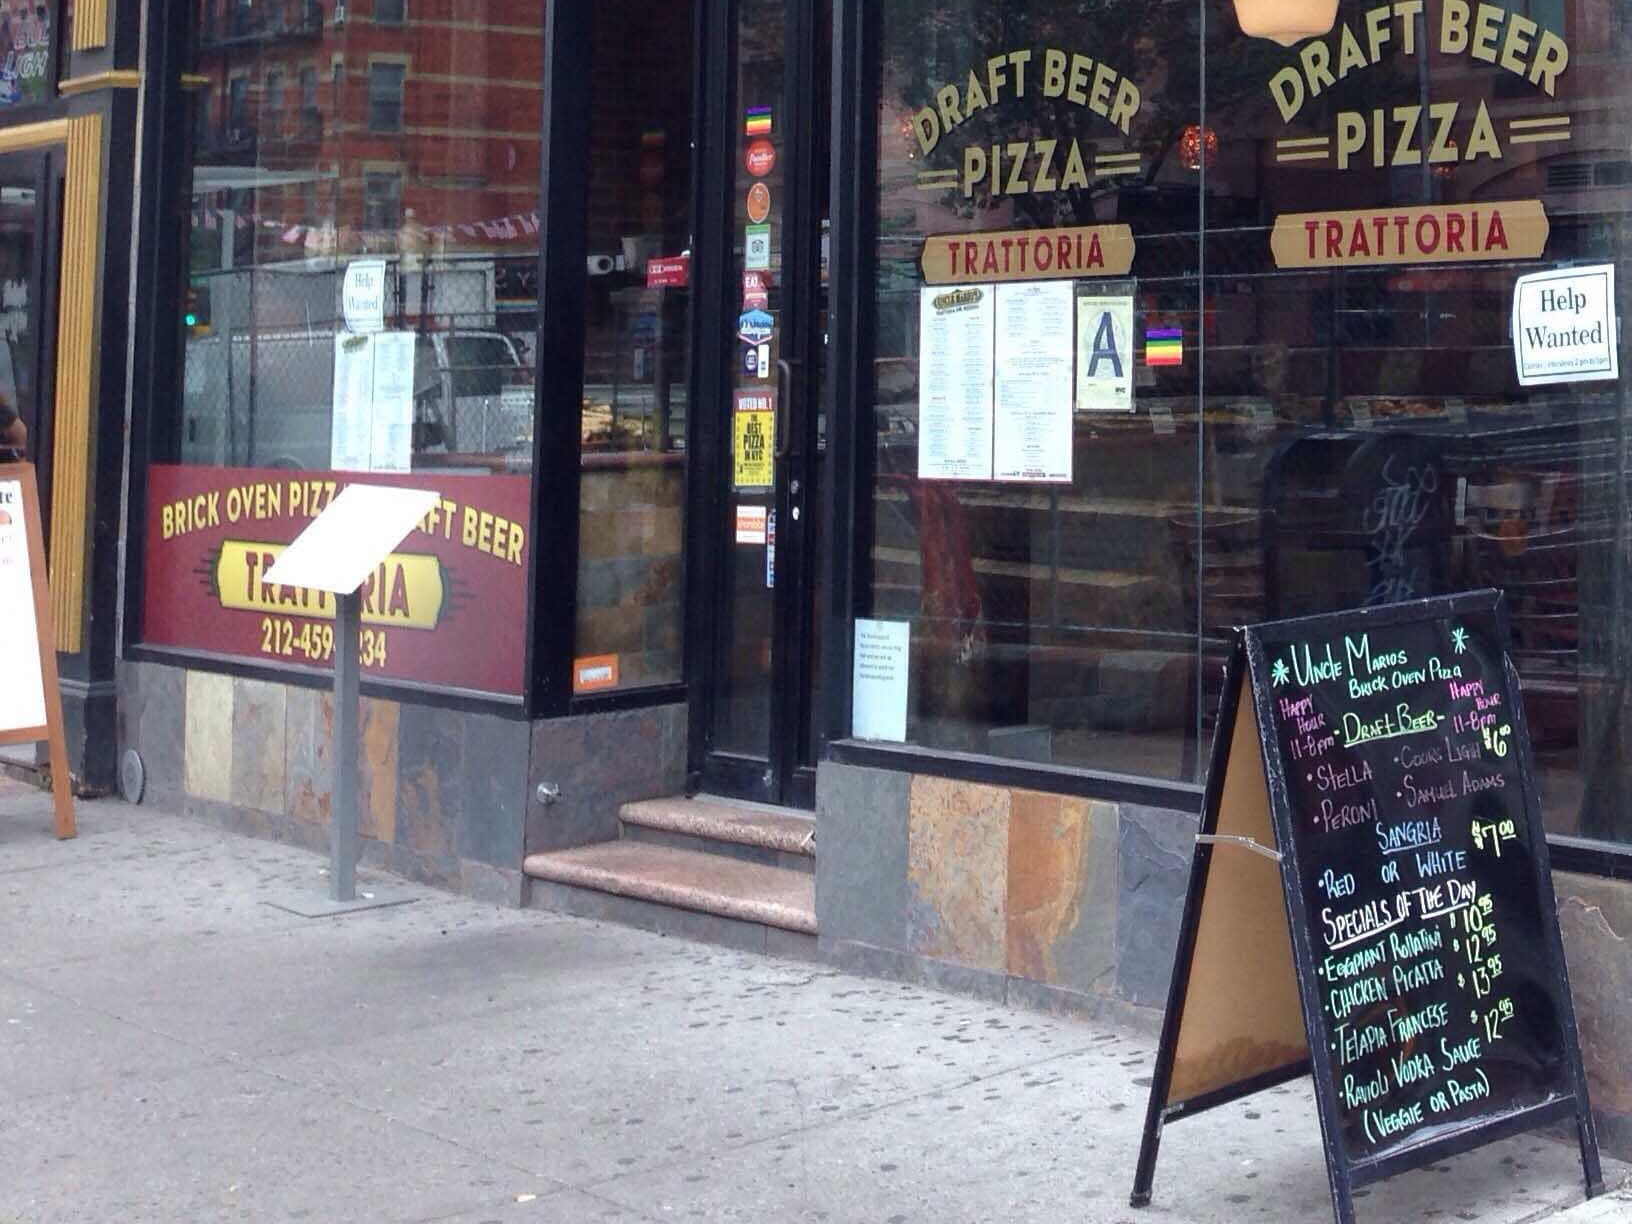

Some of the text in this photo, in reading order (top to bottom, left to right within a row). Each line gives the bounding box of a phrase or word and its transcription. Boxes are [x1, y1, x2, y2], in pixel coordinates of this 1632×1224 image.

[1268, 0, 1423, 124] DRAFT
[911, 49, 1143, 157] DRAFT BEER
[1337, 98, 1503, 170] PIZZA
[964, 138, 1088, 198] PIZZA
[949, 232, 1104, 275] TRATTORIA
[1305, 210, 1509, 258] TRATTORIA
[1541, 286, 1586, 314] Help
[1088, 311, 1123, 377] A
[1525, 321, 1603, 351] Wanted
[744, 434, 764, 450] PIZZA
[162, 490, 220, 539] BRICK
[226, 482, 281, 523] OVEN
[289, 481, 337, 518] PIZZ
[462, 505, 525, 566] BEER
